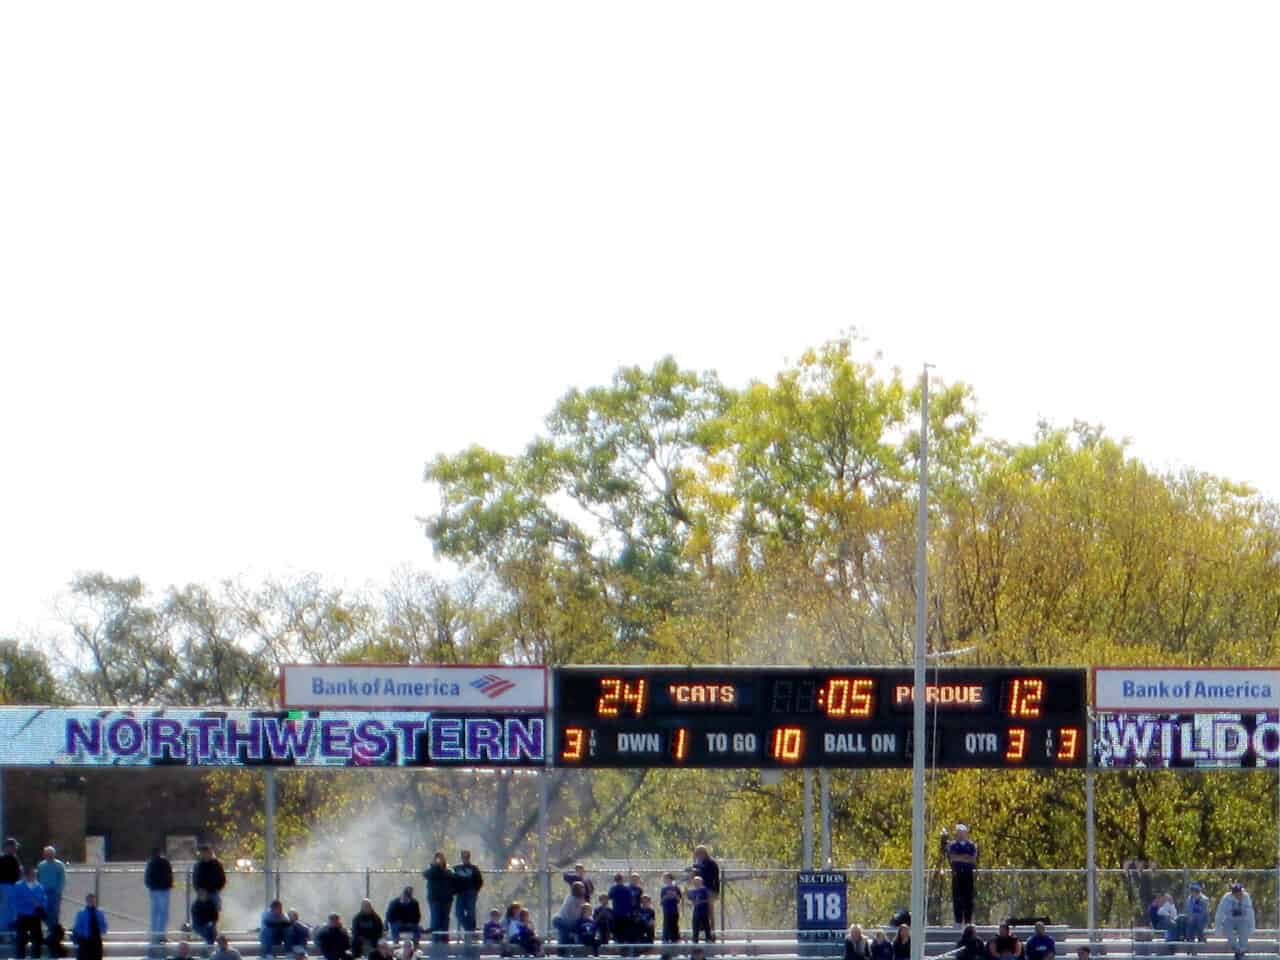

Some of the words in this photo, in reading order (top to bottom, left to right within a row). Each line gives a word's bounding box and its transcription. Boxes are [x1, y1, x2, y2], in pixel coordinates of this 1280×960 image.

[312, 677, 357, 696] Bank
[359, 677, 382, 696] of
[383, 677, 460, 696] America
[599, 679, 645, 713] 24
[896, 686, 983, 703] PRDUE
[1011, 680, 1043, 715] 12
[1122, 680, 1168, 698] Bank
[1172, 680, 1190, 698] of
[1193, 681, 1272, 698] America
[64, 717, 545, 761] NORTHWESTERN
[563, 729, 583, 758] 3
[617, 733, 659, 752] DWN
[706, 733, 728, 752] TO
[733, 733, 756, 752] GO
[774, 728, 801, 759] 10
[824, 733, 866, 753] BALL
[871, 733, 896, 753] ON
[965, 733, 998, 754] QTR
[1006, 729, 1025, 758] 3
[1058, 729, 1077, 758] 3
[799, 873, 845, 884] SECTION
[803, 893, 841, 920] 118
